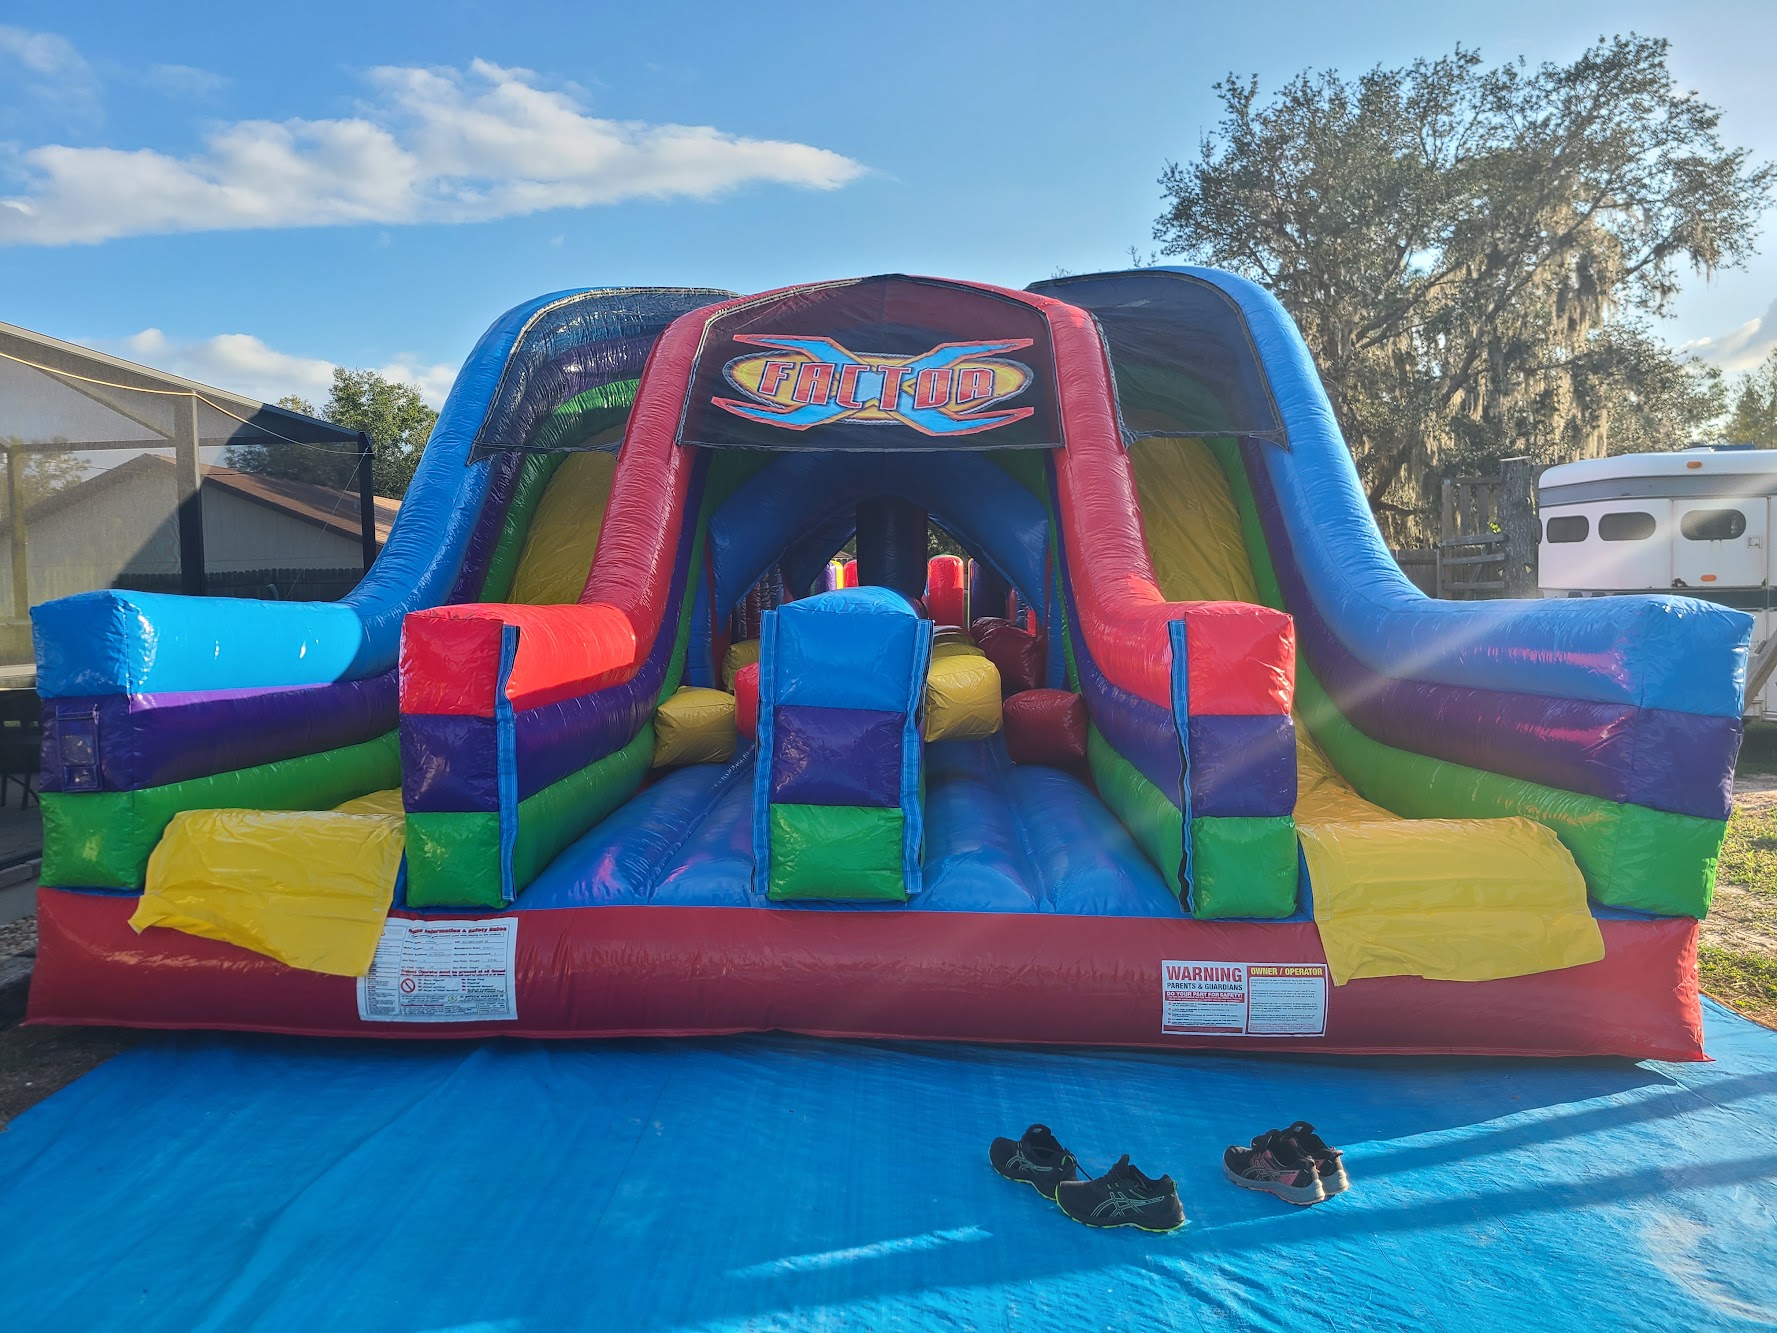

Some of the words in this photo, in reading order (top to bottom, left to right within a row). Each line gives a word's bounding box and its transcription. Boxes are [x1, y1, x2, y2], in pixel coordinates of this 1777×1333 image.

[758, 360, 994, 411] FACTOR
[1166, 966, 1242, 982] WARNING
[1250, 967, 1278, 975] OWNER
[1280, 967, 1284, 975] /
[1285, 967, 1323, 976] OPERATOR
[1205, 983, 1243, 991] GUARDIANS
